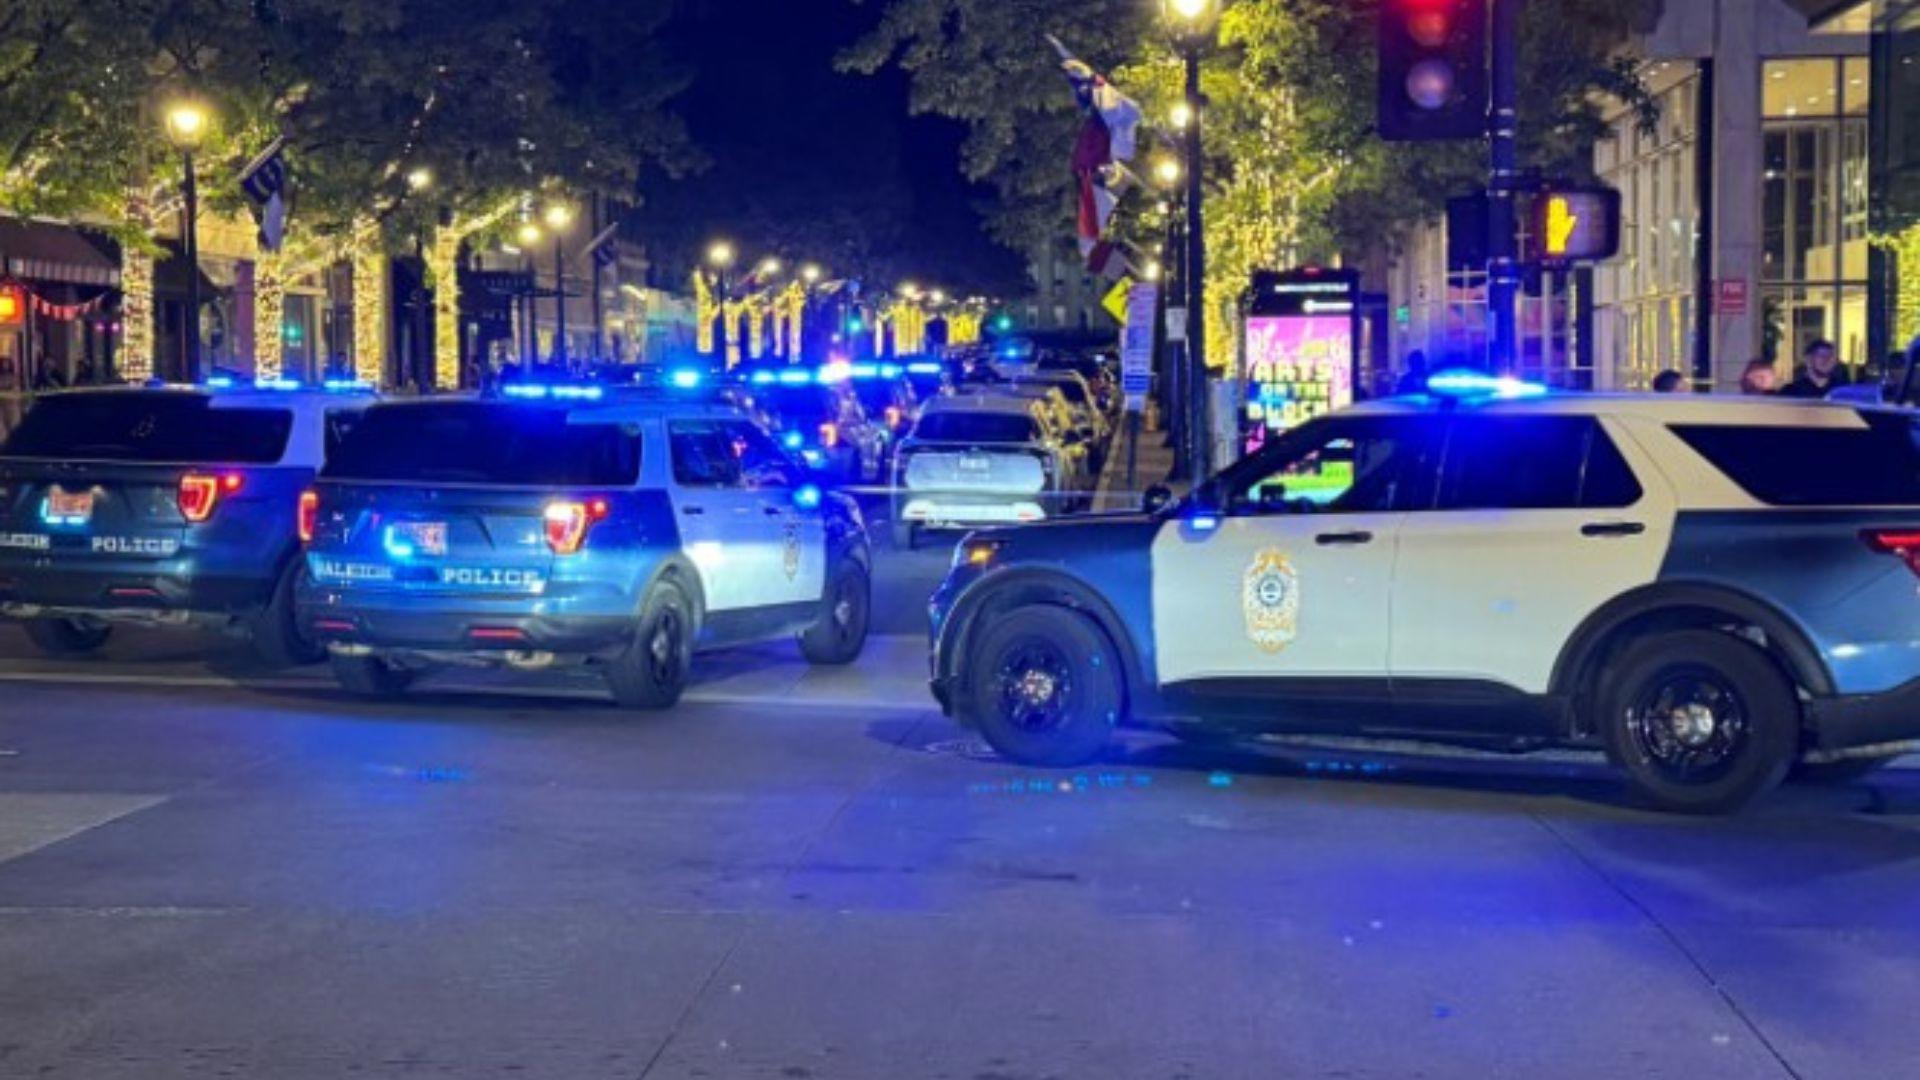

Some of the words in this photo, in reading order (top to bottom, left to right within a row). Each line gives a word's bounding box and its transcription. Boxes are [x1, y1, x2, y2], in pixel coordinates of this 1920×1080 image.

[1253, 361, 1332, 381] ARTS
[1259, 383, 1288, 398] ON
[91, 536, 176, 555] POLICE
[442, 567, 539, 588] POLICE
